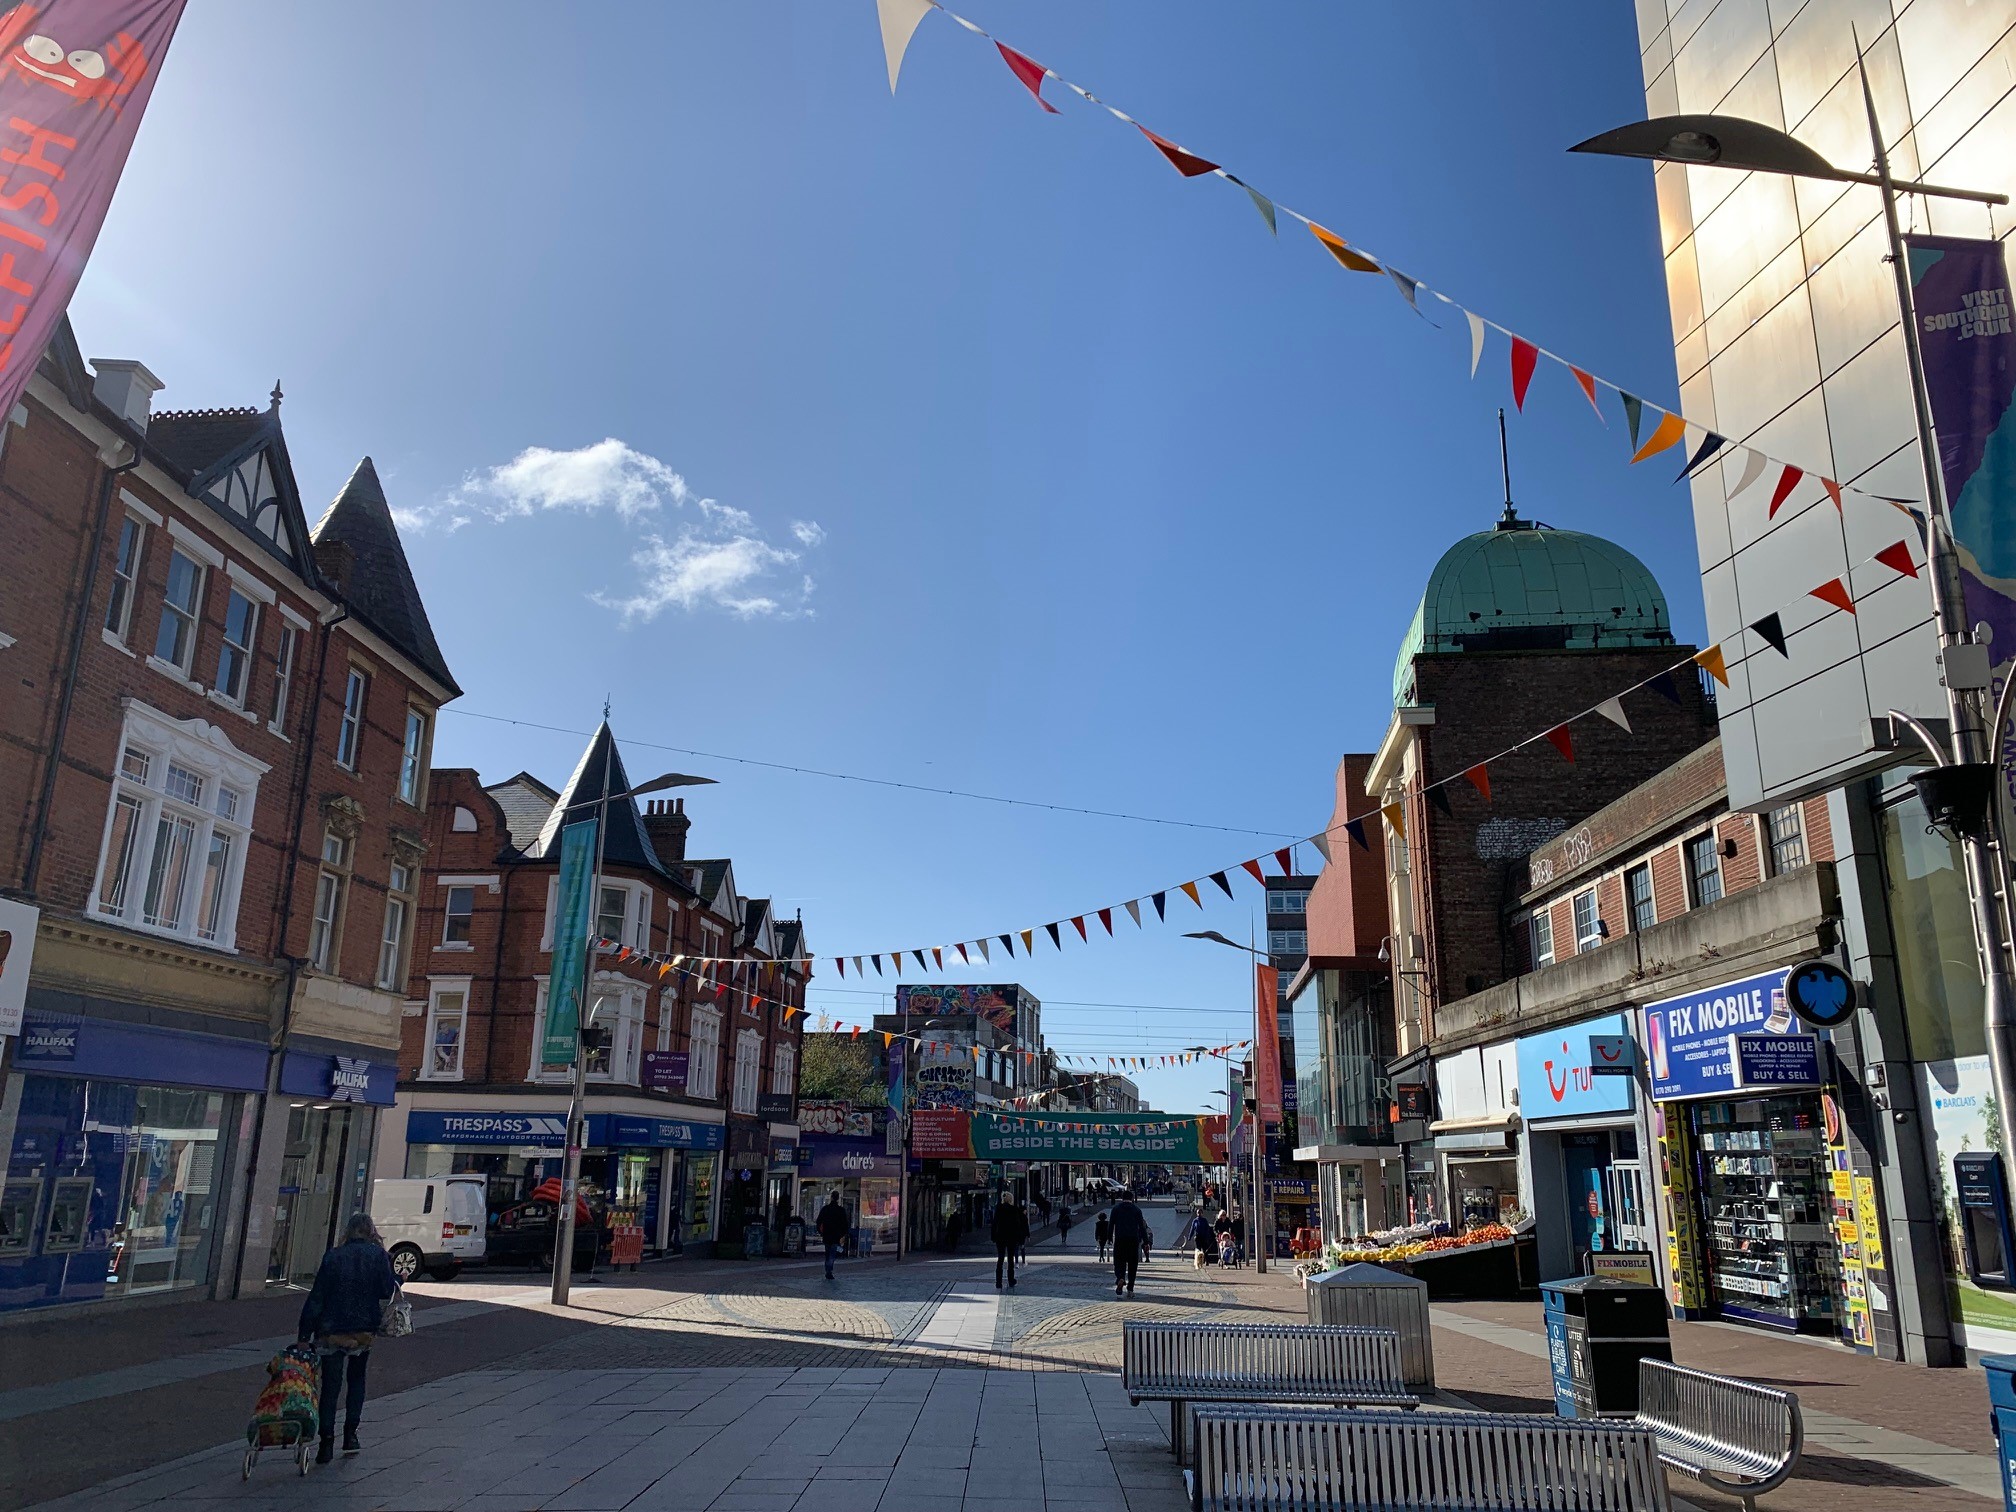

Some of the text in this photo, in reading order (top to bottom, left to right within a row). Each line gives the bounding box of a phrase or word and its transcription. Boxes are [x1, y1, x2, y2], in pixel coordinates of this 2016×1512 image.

[1962, 289, 2005, 308] VISIT
[1924, 304, 2009, 332] SOUTHEND
[1958, 318, 2012, 340] .CO.UK
[1669, 989, 1764, 1038] FIX MOBILE
[26, 1036, 76, 1046] HALIFAX
[1686, 1041, 1701, 1050] PHONES
[1741, 1042, 1813, 1052] FIX MOBILE
[1712, 1047, 1726, 1056] LAPTOP
[1702, 1063, 1734, 1077] BUY & SEL
[1753, 1071, 1809, 1079] BUY & SELL
[333, 1070, 370, 1089] HALIFAX
[1265, 1062, 1275, 1096] CITY
[1943, 1097, 1976, 1107] BARCLAYS
[444, 1118, 522, 1132] TRESPASS
[660, 1125, 680, 1138] TRESPASS
[1035, 1123, 1039, 1132] I
[1043, 1123, 1068, 1133] DO
[1078, 1124, 1111, 1135] LIKE
[1118, 1124, 1139, 1136] TO
[1145, 1124, 1168, 1135] BE
[989, 1137, 1053, 1150] BESIDE
[1058, 1137, 1093, 1148] THE
[842, 1152, 874, 1170] claire's
[1279, 1186, 1305, 1194] REPAIRS
